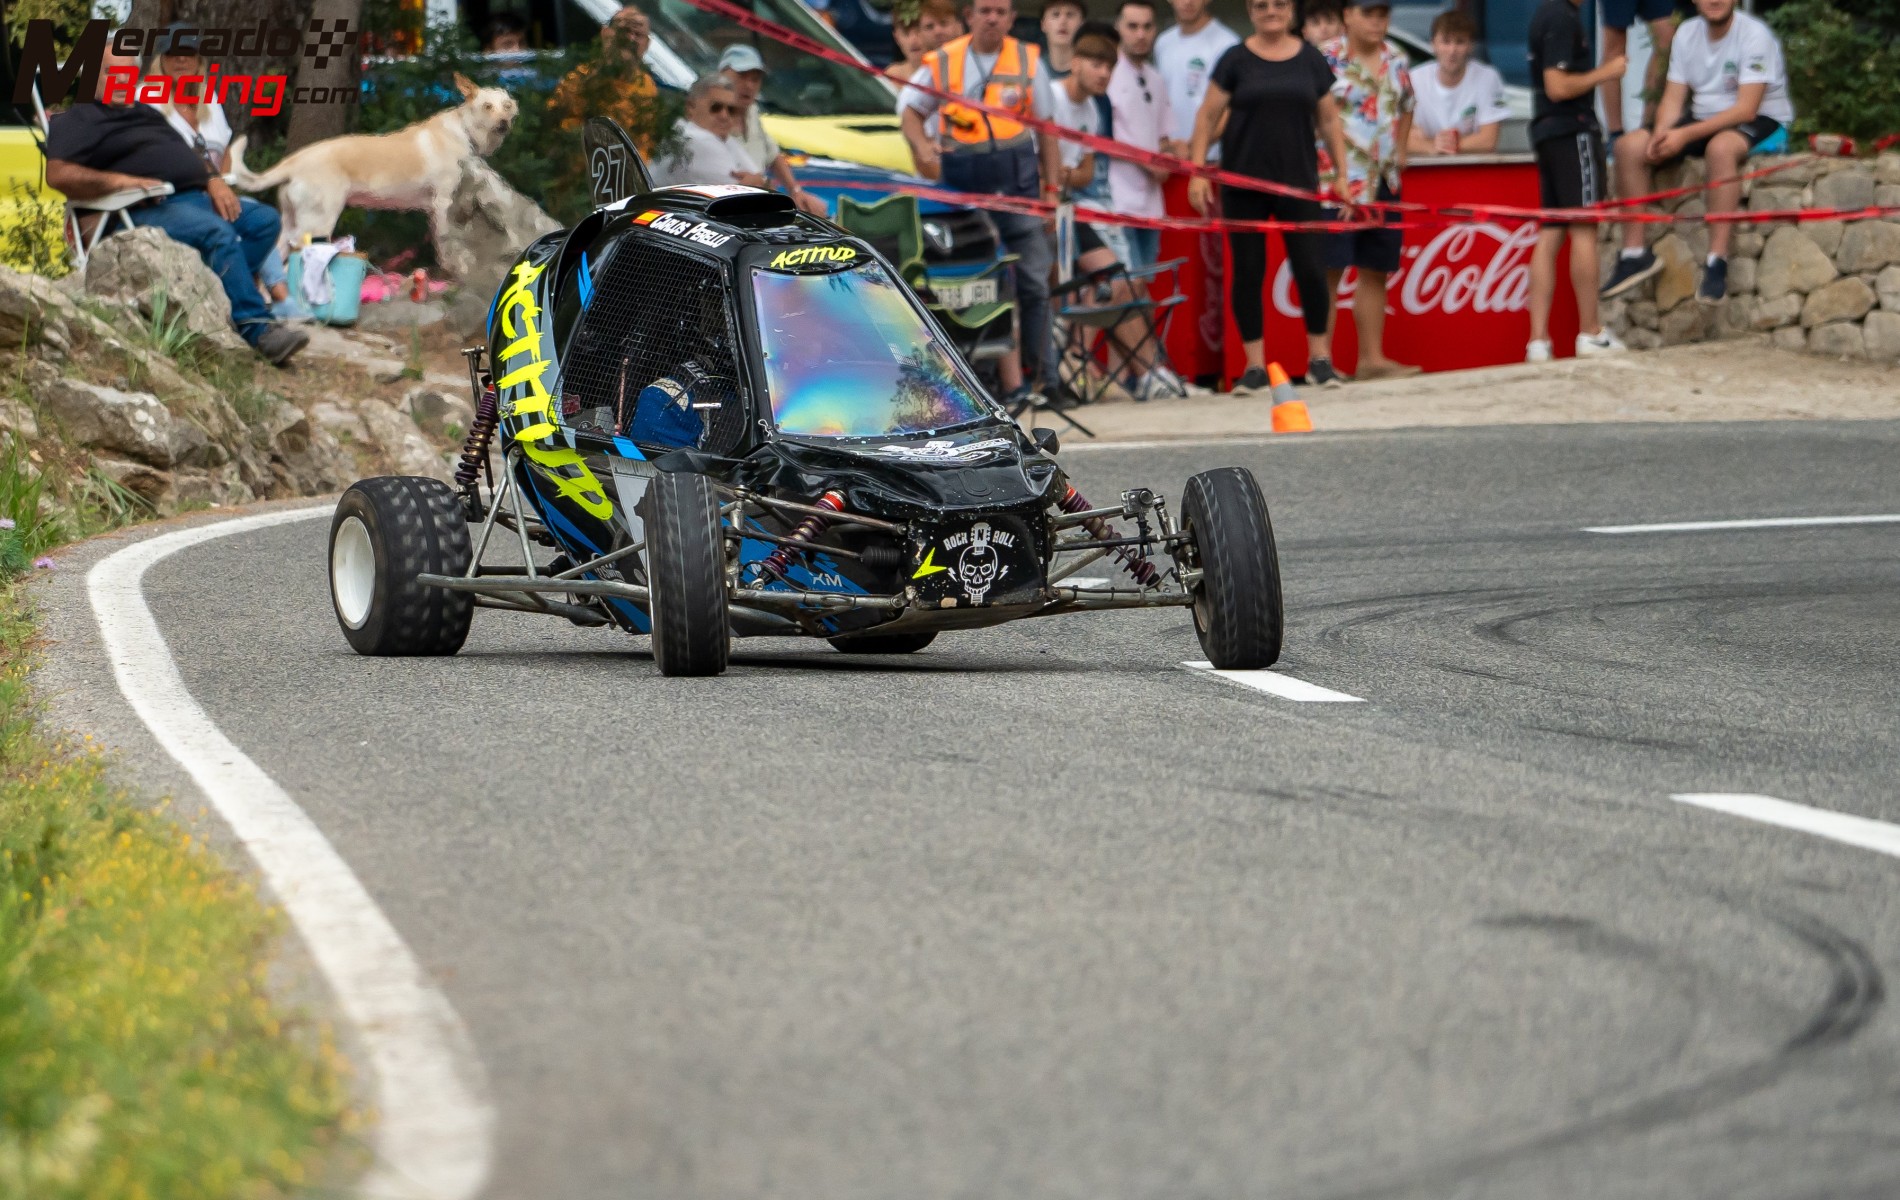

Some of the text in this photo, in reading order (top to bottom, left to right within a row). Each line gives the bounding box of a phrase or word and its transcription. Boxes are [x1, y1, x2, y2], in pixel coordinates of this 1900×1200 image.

[591, 143, 627, 208] 27
[770, 246, 856, 269] ACTITUD
[496, 260, 614, 521] ACTITUD
[942, 528, 1016, 551] ROCK N ROLL
